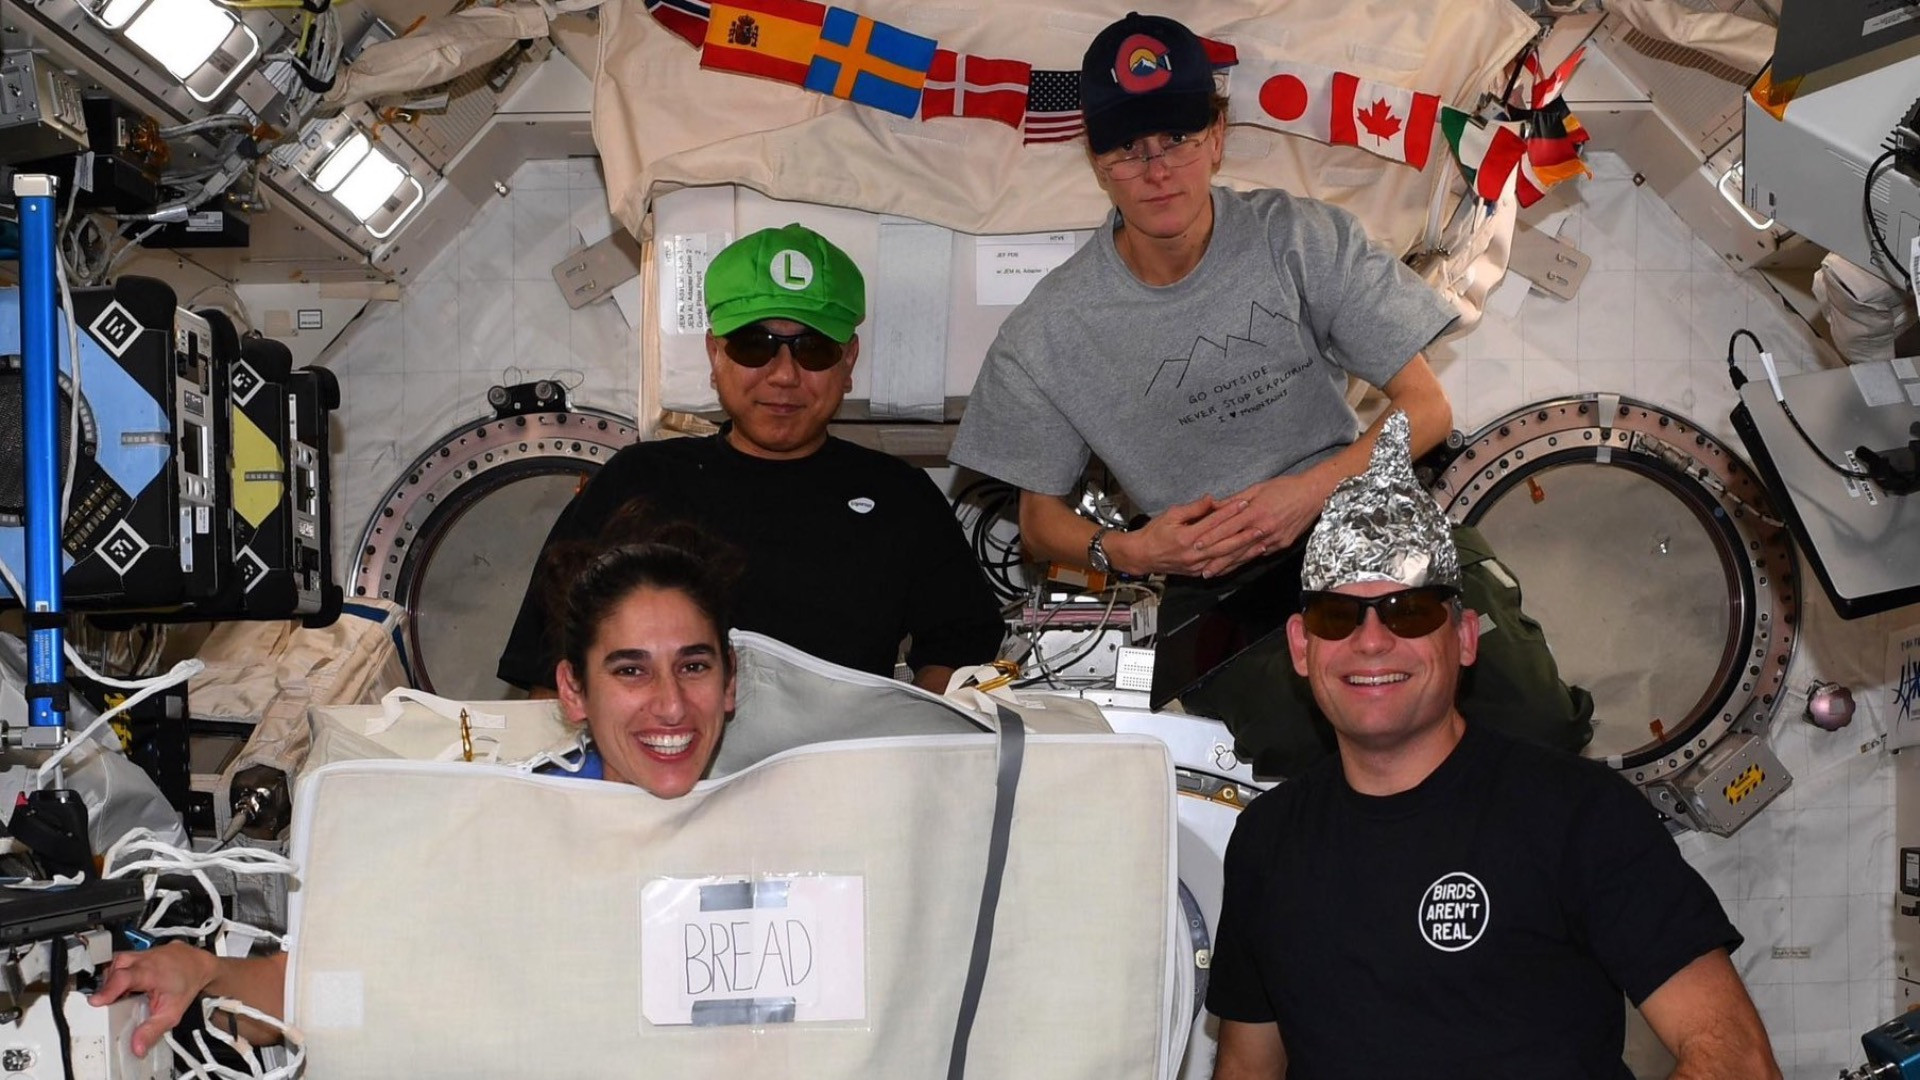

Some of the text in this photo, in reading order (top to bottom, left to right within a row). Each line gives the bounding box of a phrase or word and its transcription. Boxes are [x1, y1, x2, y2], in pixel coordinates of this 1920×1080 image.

[784, 252, 806, 286] L
[687, 303, 694, 312] AL
[1178, 357, 1314, 426] NEVER STOP EXPLORING
[1188, 365, 1269, 404] GO OUTSIDE
[1239, 388, 1288, 416] MOUNTAINS
[1433, 883, 1476, 901] BIRDS
[1426, 902, 1480, 921] AREN'T
[1433, 922, 1473, 941] REAL
[684, 919, 813, 995] BREAD
